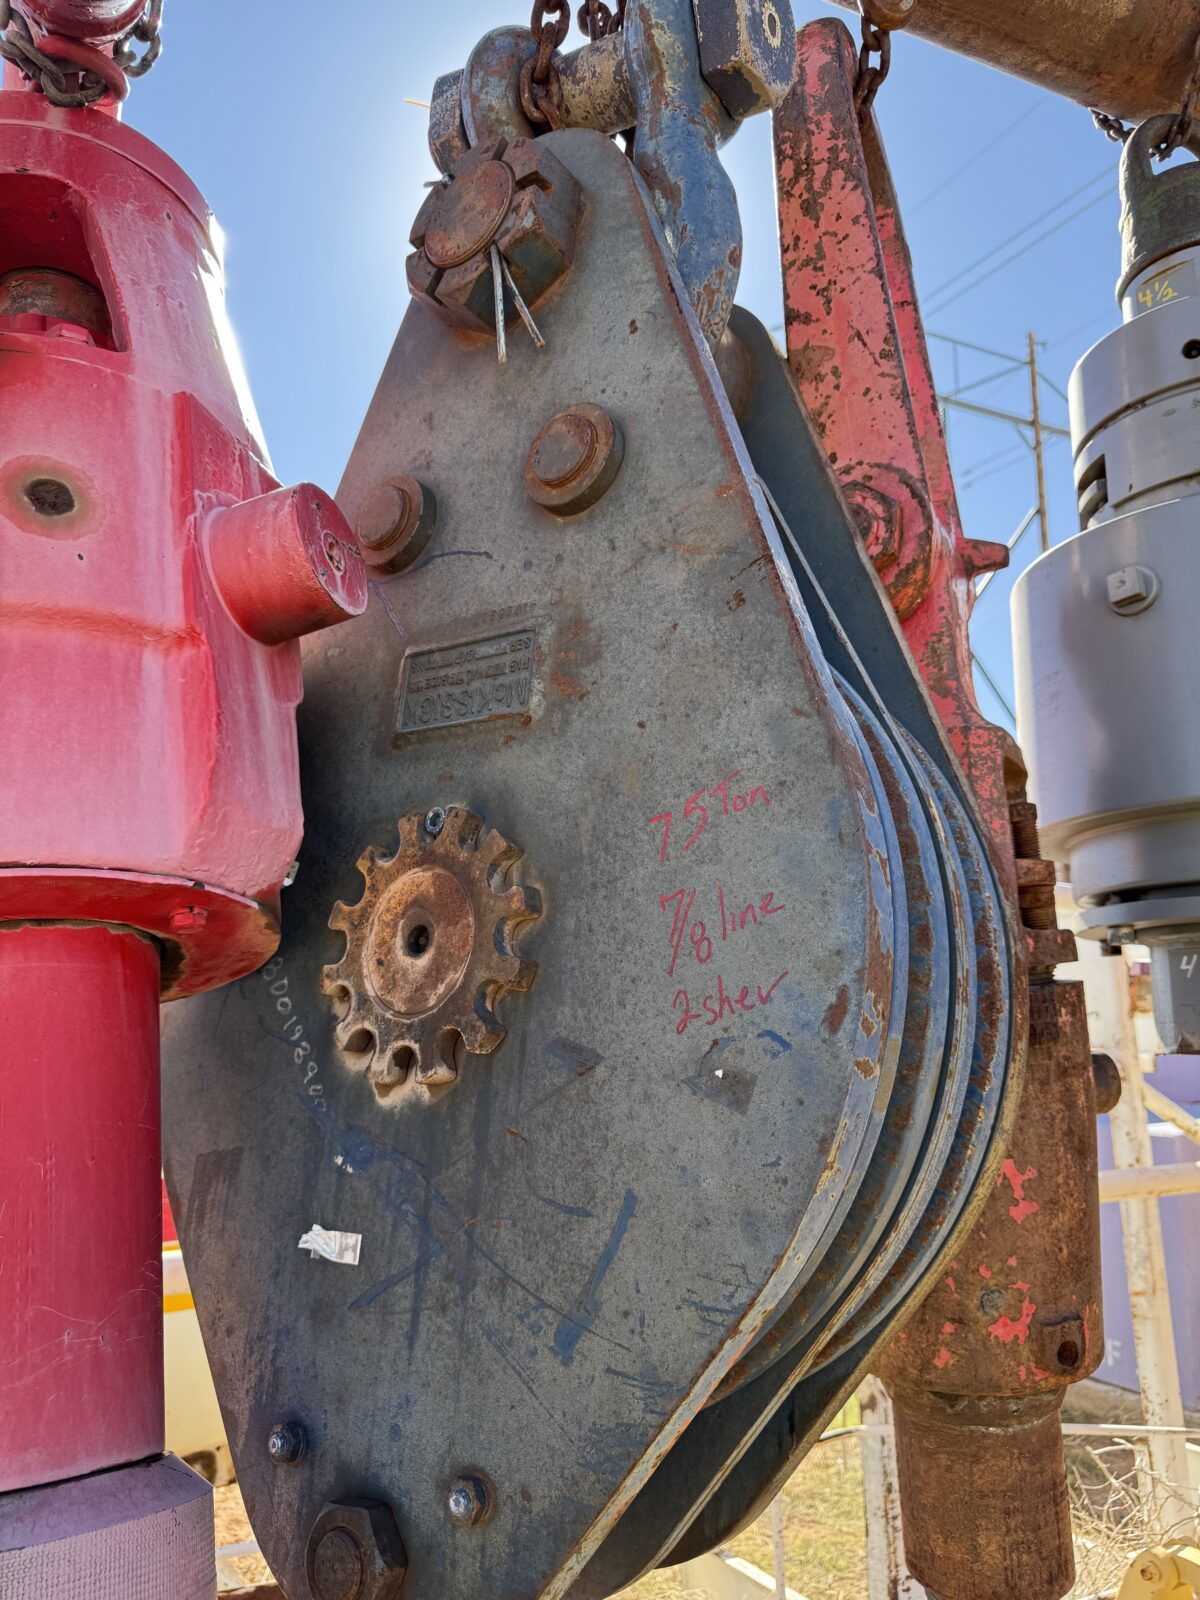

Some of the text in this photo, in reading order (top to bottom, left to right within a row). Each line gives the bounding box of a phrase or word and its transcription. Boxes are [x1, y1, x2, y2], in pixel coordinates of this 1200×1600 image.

[509, 657, 530, 673] FIG
[650, 768, 771, 863] 75 Ton
[659, 884, 785, 977] 7/8 line
[1179, 953, 1198, 979] 4
[671, 989, 702, 1035] 2
